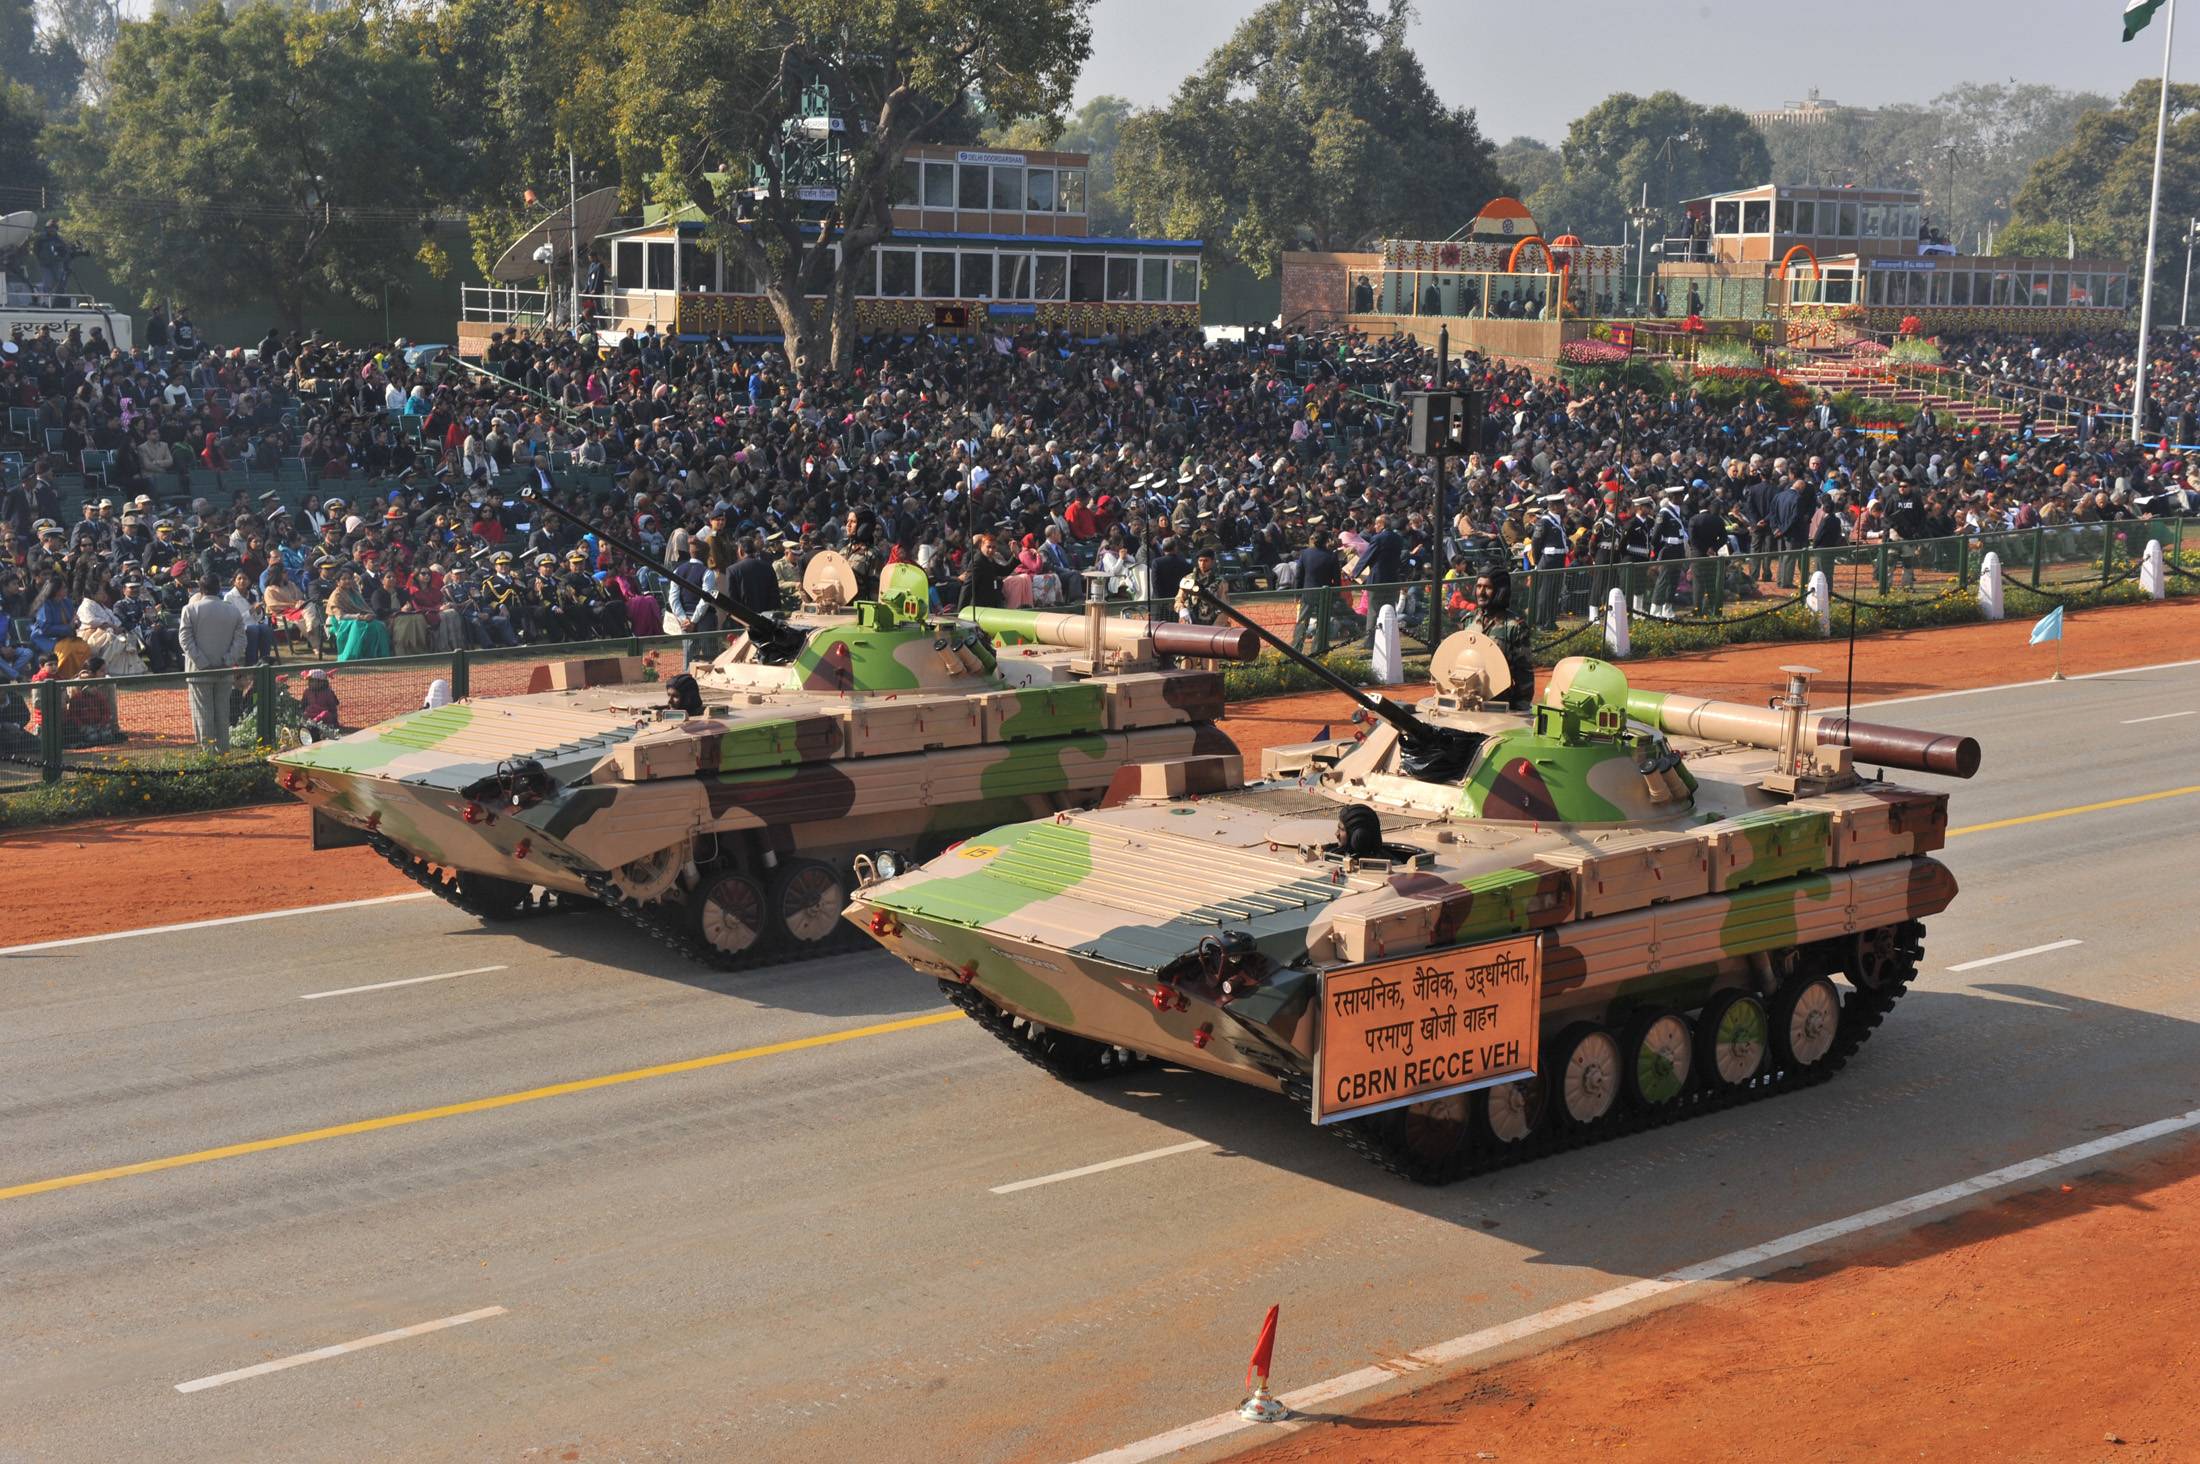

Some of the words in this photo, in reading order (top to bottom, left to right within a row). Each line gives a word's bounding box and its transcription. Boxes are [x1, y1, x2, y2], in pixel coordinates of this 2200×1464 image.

[1333, 977, 1405, 1016] रसायनिक,
[1413, 966, 1458, 1000] जैविक,
[1365, 1021, 1414, 1056] परमाणु
[1420, 1004, 1457, 1041] खोजी
[1463, 1004, 1499, 1033] वाहन
[1337, 1066, 1397, 1103] CBRN
[1404, 1049, 1474, 1088] RECCE
[1480, 1040, 1520, 1071] VEH
